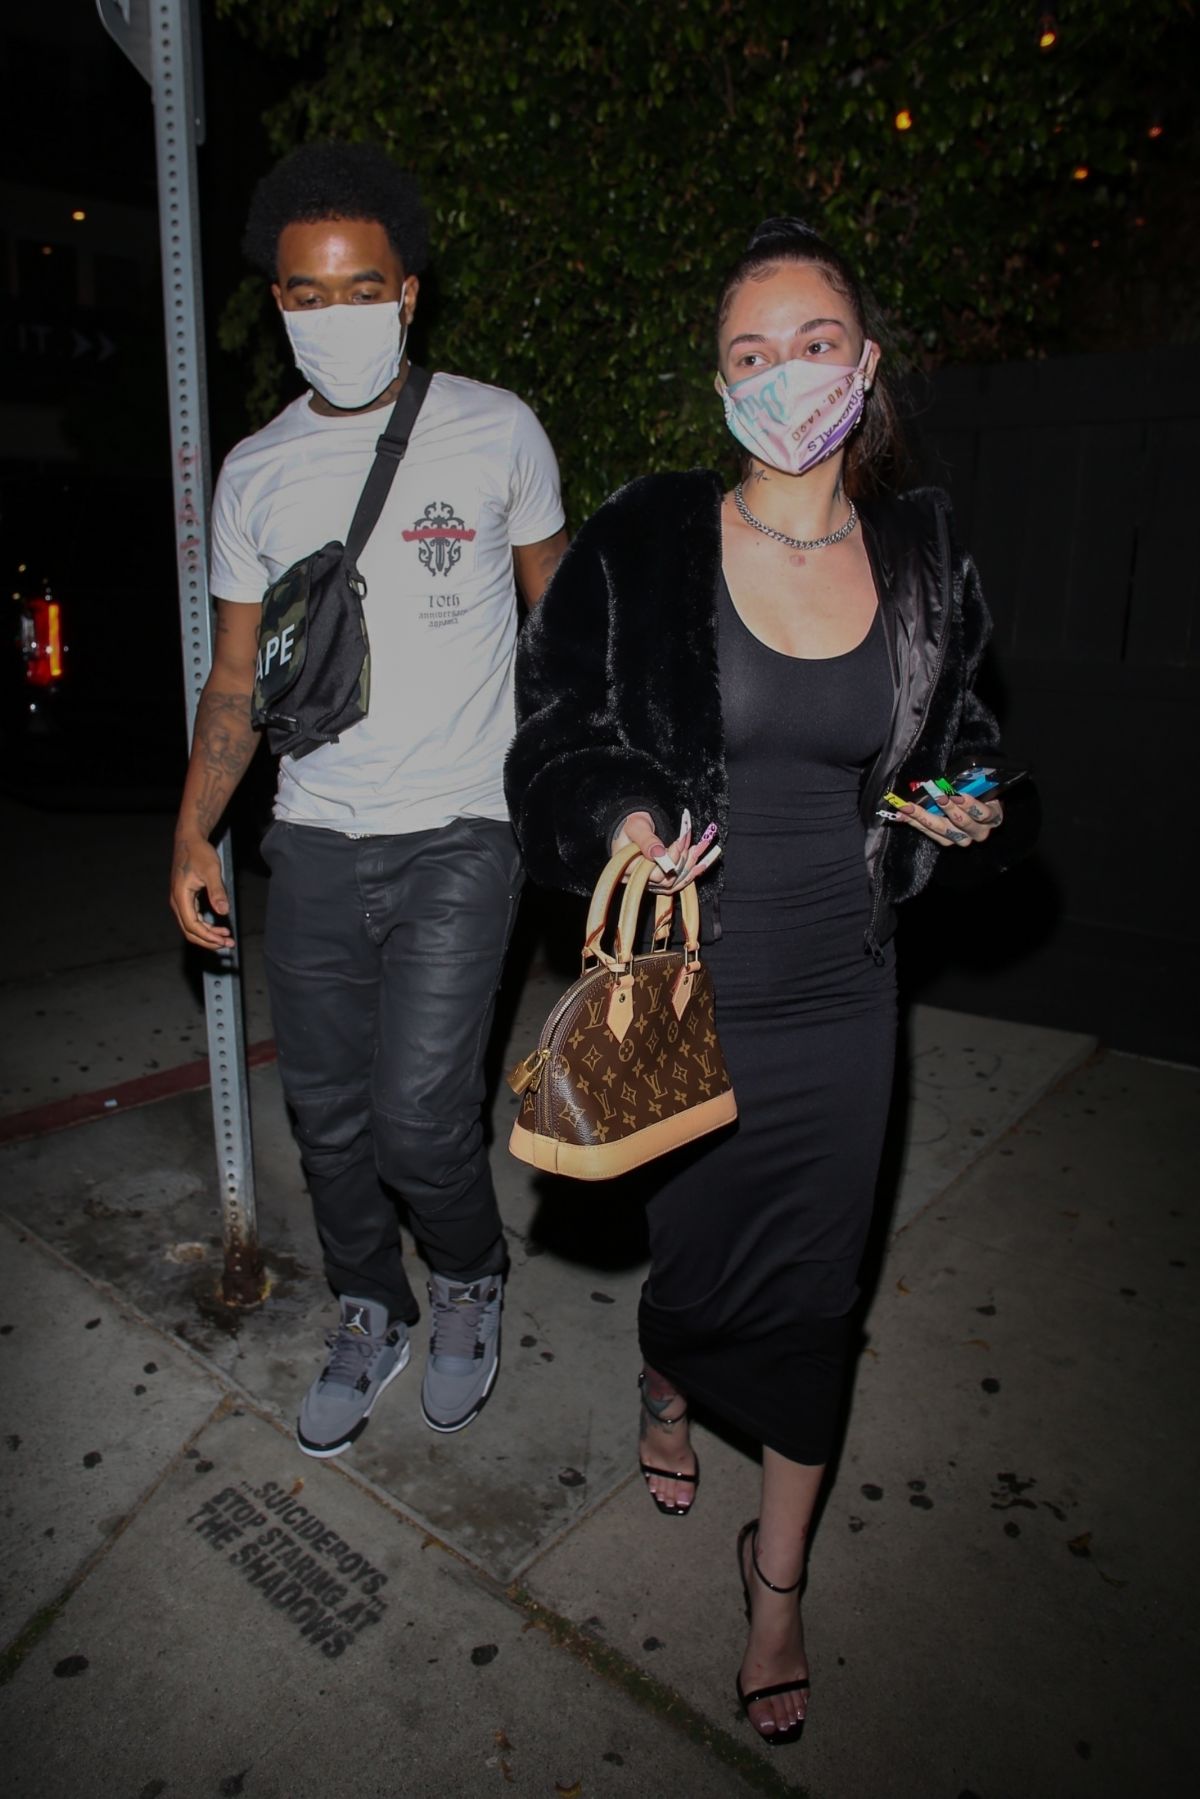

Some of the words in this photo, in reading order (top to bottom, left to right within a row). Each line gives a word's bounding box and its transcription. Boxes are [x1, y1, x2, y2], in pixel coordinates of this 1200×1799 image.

[429, 593, 460, 608] 10th
[255, 624, 295, 686] APE
[187, 1501, 244, 1551] THE
[229, 1543, 355, 1658] SHADOWS
[212, 1487, 267, 1529] STOP
[257, 1527, 348, 1610] STARING
[336, 1602, 381, 1633] AT
